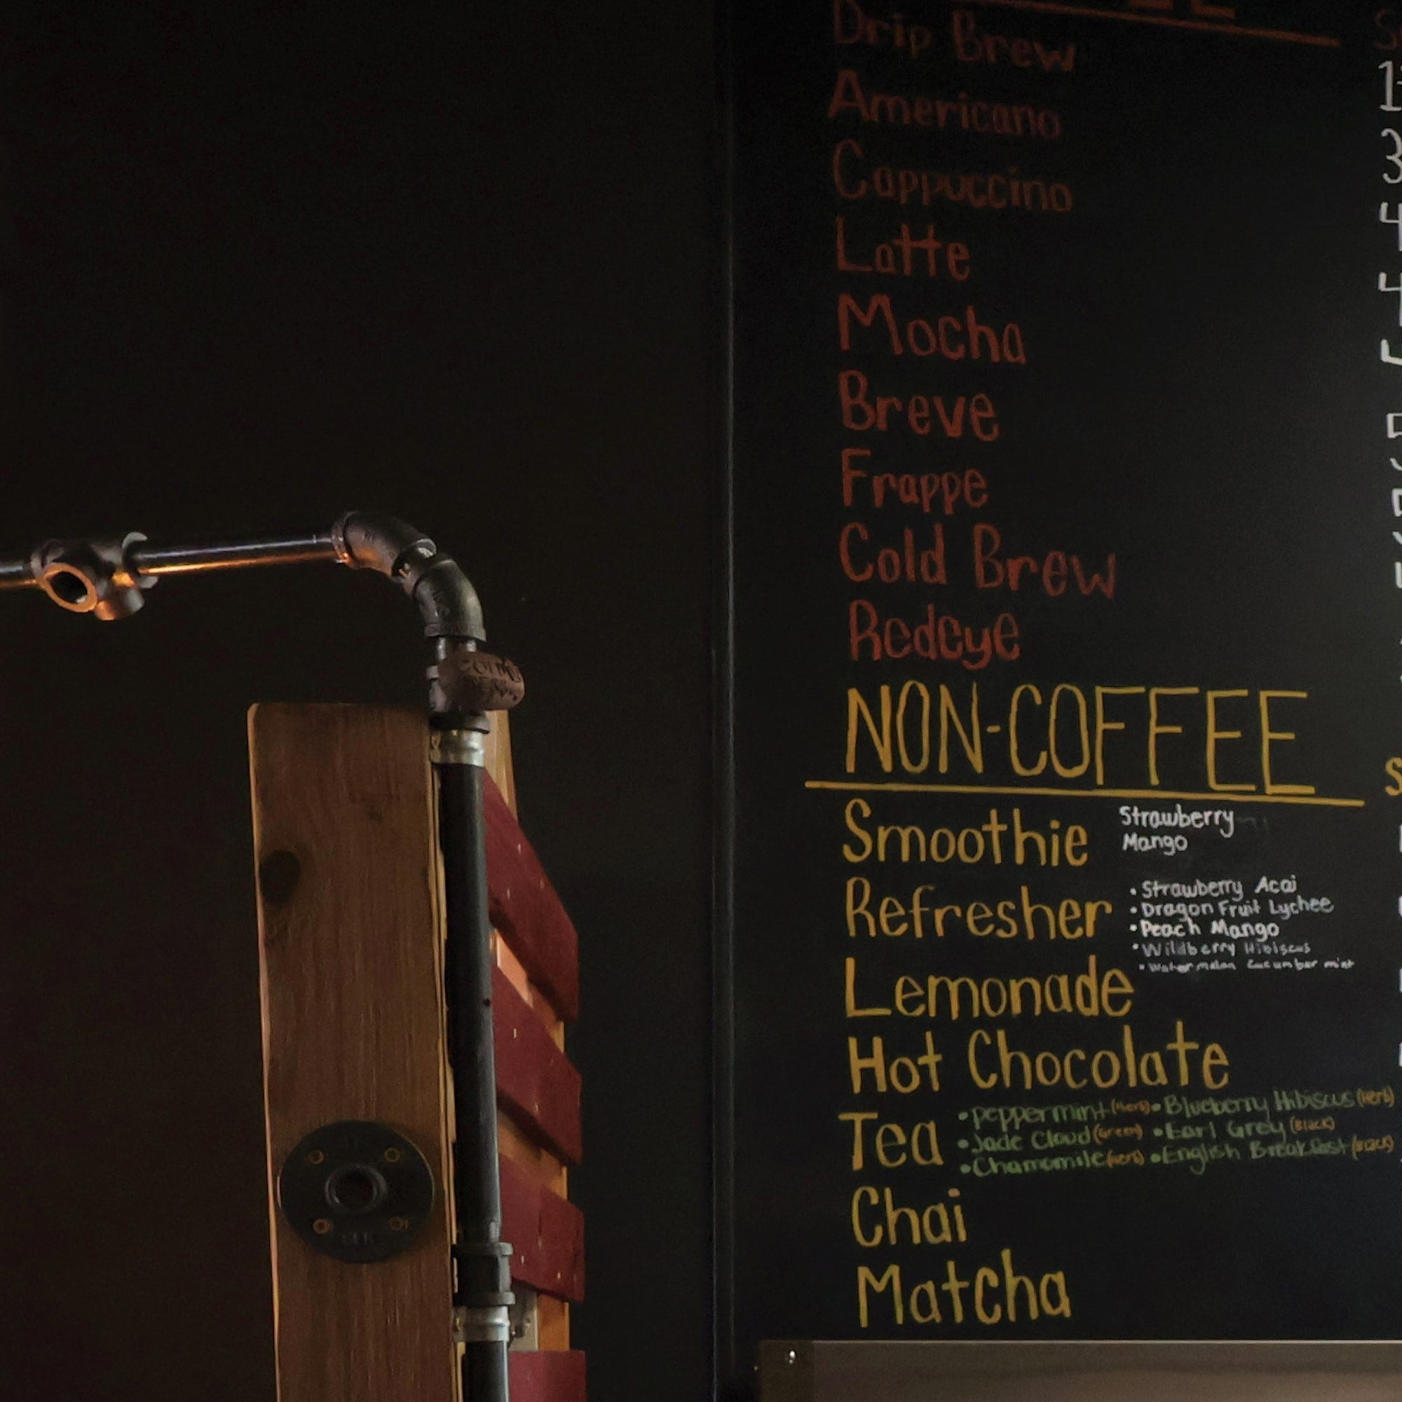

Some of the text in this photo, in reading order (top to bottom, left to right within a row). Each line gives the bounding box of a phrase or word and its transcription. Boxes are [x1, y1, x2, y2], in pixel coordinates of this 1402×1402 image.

[953, 8, 1077, 72] Brew
[827, 69, 1063, 139] Americano
[832, 137, 1074, 214] Cappuccino
[835, 215, 971, 281] Latte
[837, 293, 1026, 364] Mocha
[838, 369, 999, 442] Breve
[840, 447, 989, 515] Frappe
[839, 522, 1116, 599] Cold Brew
[849, 599, 1022, 670] Redeye
[845, 680, 1315, 795] NON-COFFEE
[842, 797, 1235, 867] Smoothie Strawberry
[1122, 832, 1189, 856] Mango
[845, 876, 1113, 940] Refresher
[1141, 874, 1298, 902] Strawberry Acai
[1141, 894, 1335, 922] Dragon Fruit Lychee
[1139, 917, 1280, 943] Peach Mango
[845, 955, 1135, 1021] Lemonade
[847, 1020, 1231, 1096] Hot Chocolate
[838, 1111, 944, 1172] Tea
[850, 1185, 968, 1249] Chai
[856, 1249, 1073, 1329] Matcha
